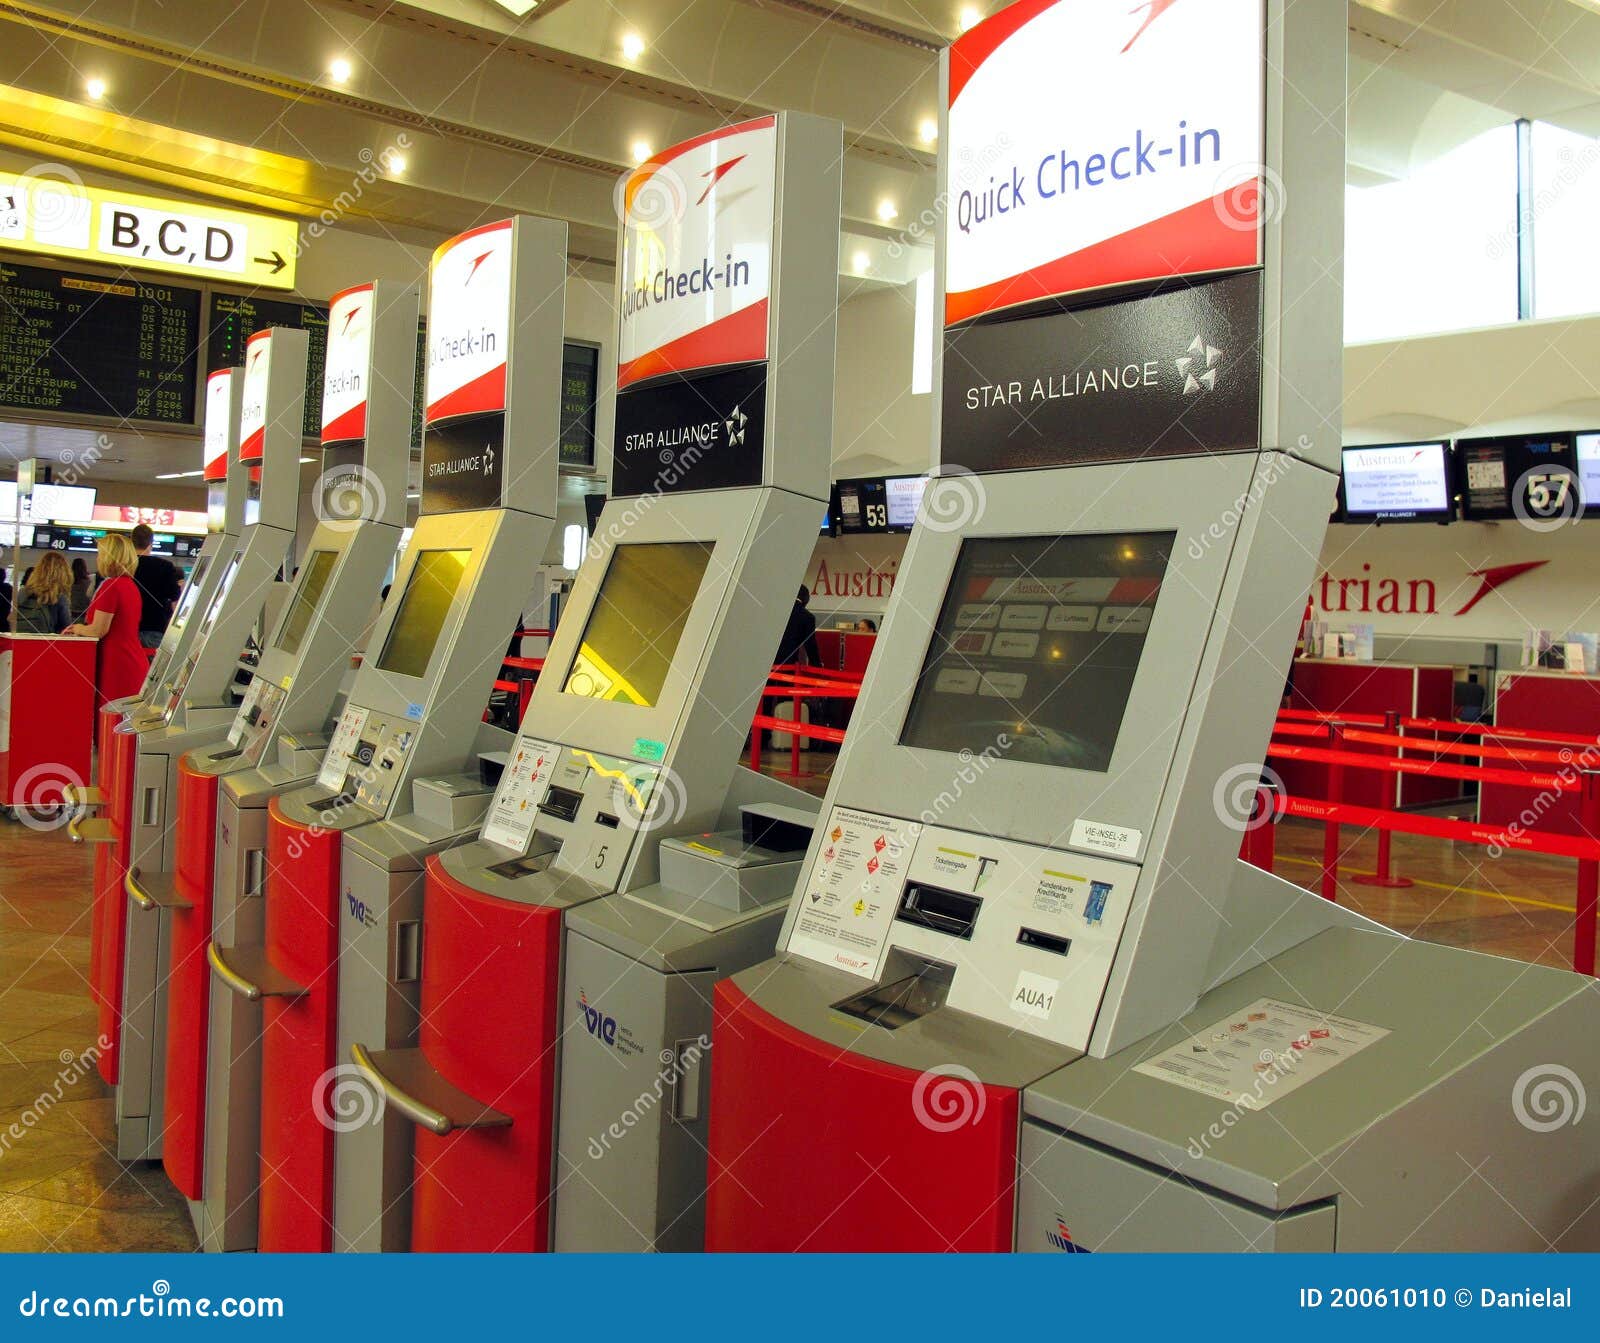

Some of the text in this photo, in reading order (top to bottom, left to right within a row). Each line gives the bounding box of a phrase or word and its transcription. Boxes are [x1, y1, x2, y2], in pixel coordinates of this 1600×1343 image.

[958, 120, 1221, 234] Quick Check-in
[653, 254, 749, 304] Check-in
[0, 334, 53, 348] ELGRADE
[0, 343, 50, 357] ELSINKI
[0, 353, 37, 366] UMBAI
[0, 363, 50, 377] ALENCIA
[0, 383, 36, 395] ERLIN
[966, 361, 1159, 411] STAR ALLIANCE
[625, 422, 719, 452] STAR ALLIANCE
[429, 457, 480, 478] STAR ALLIANCE
[1527, 473, 1571, 509] 57
[866, 504, 886, 527] 53
[51, 539, 66, 550] 40
[811, 559, 898, 598] Austri
[1318, 563, 1440, 615] trian
[1291, 801, 1325, 815] Austrian
[594, 845, 609, 870] 5
[1015, 986, 1053, 1011] AUA1
